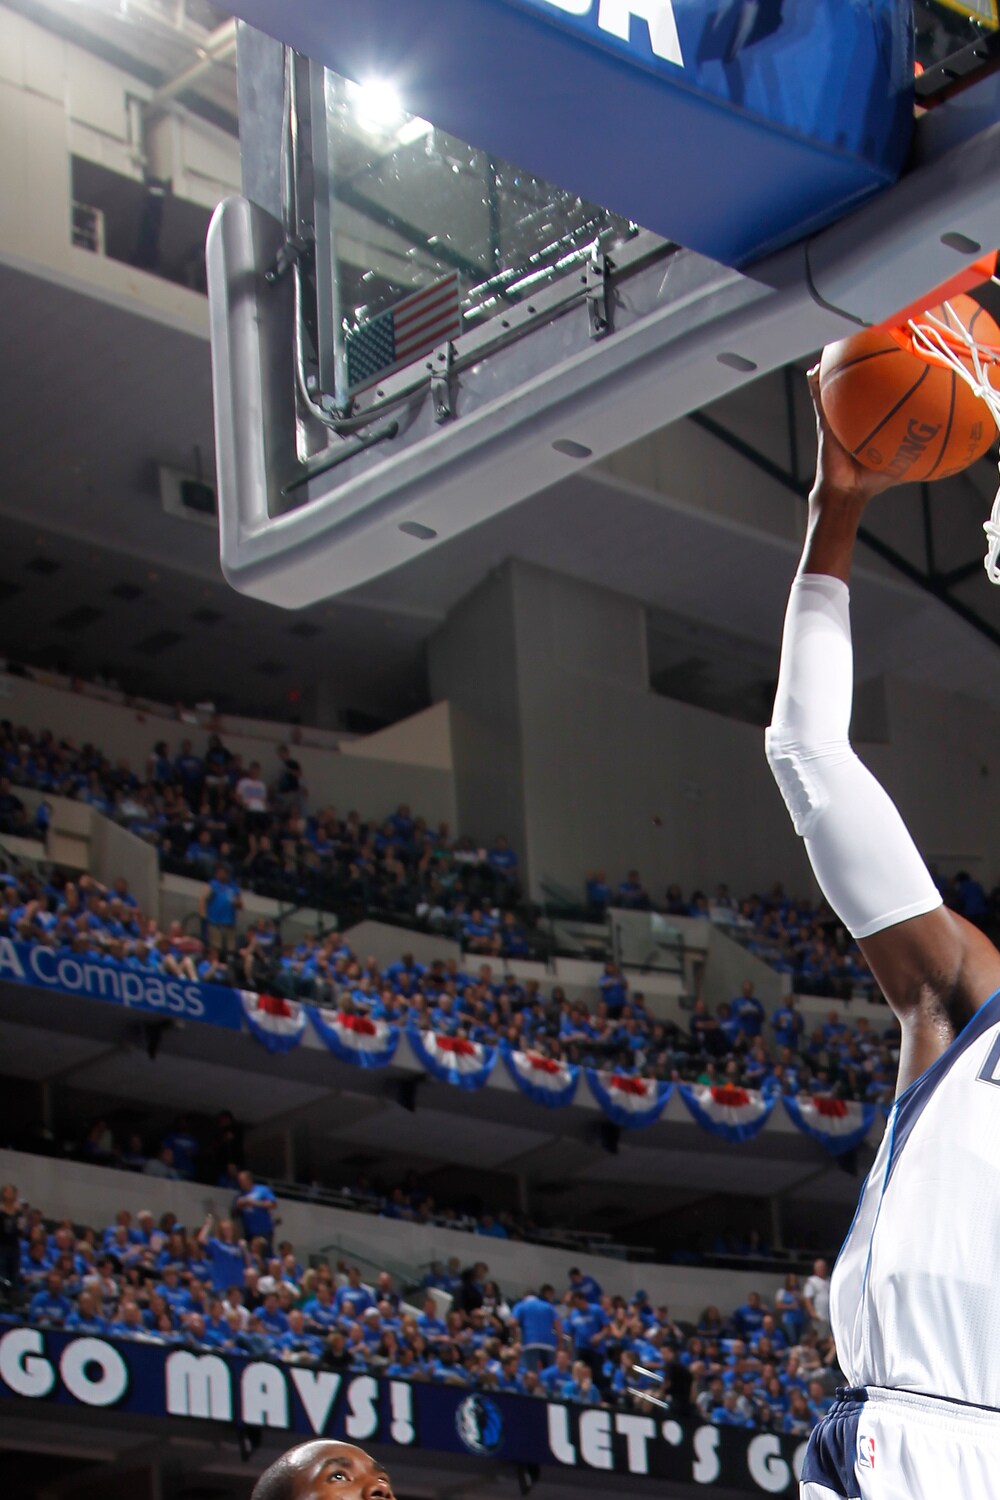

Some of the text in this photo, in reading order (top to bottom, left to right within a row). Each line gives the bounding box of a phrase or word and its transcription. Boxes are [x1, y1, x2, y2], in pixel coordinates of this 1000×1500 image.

[30, 945, 205, 1017] Compass
[0, 1327, 416, 1445] GO MAVS!
[546, 1402, 721, 1485] LET'S
